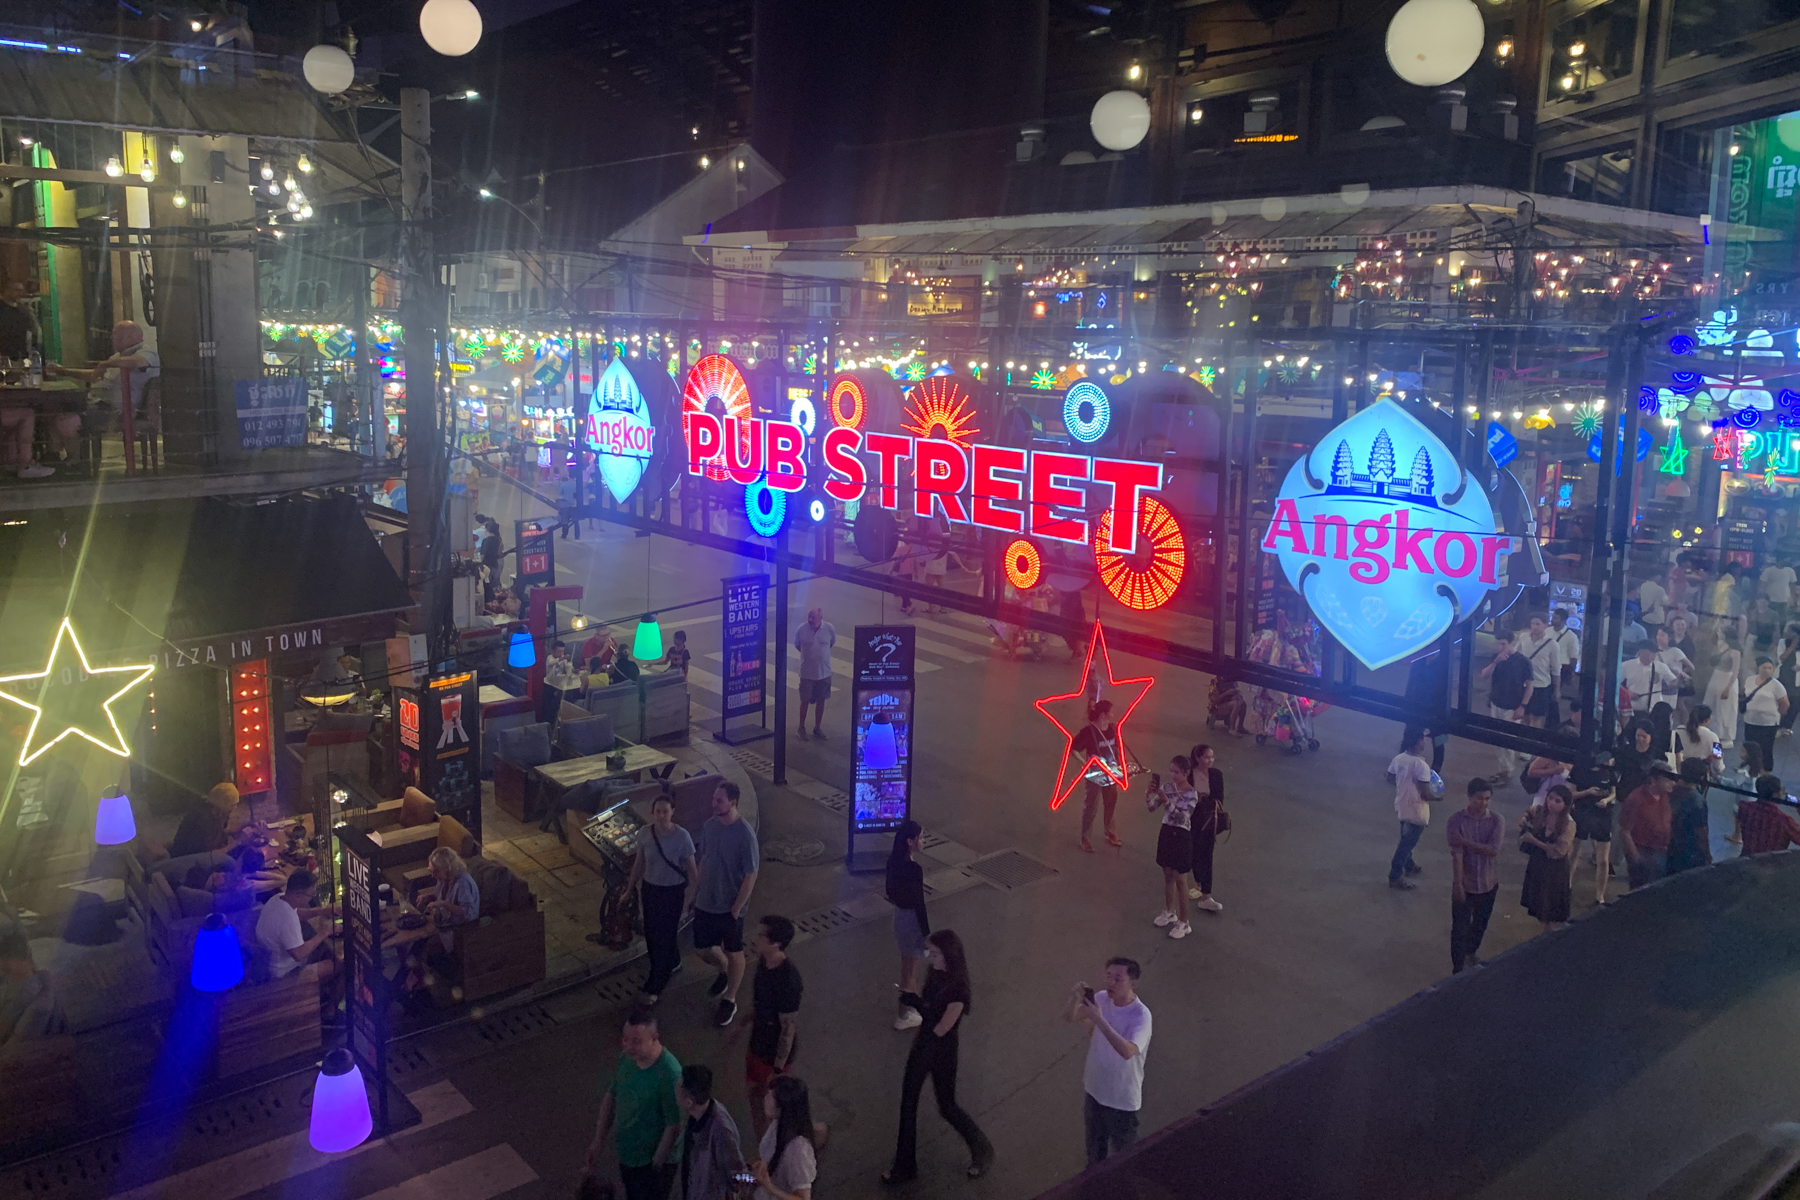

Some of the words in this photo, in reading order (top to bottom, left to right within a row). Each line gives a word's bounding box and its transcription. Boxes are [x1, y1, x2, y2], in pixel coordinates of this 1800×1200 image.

[244, 421, 263, 431] 012
[266, 420, 283, 430] 493
[243, 437, 262, 446] 096
[265, 435, 282, 445] 507
[586, 413, 655, 457] Angkor
[689, 411, 807, 492] PUB
[823, 427, 1163, 554] STREET
[1262, 498, 1511, 585] Angkor
[525, 556, 545, 572] 1+1
[1729, 551, 1751, 566] 1+1
[728, 585, 760, 603] LIVE
[728, 600, 760, 611] WESTERN
[728, 608, 760, 623] BAND
[729, 623, 759, 635] UPSTAIRS
[149, 645, 217, 667] PIZZA
[231, 640, 252, 658] IN
[265, 629, 323, 652] TOWN
[869, 693, 900, 706] TEMPLE
[399, 697, 420, 732] 20
[347, 852, 370, 892] LIVE
[349, 877, 371, 905] WESTERN
[350, 889, 372, 924] BAND
